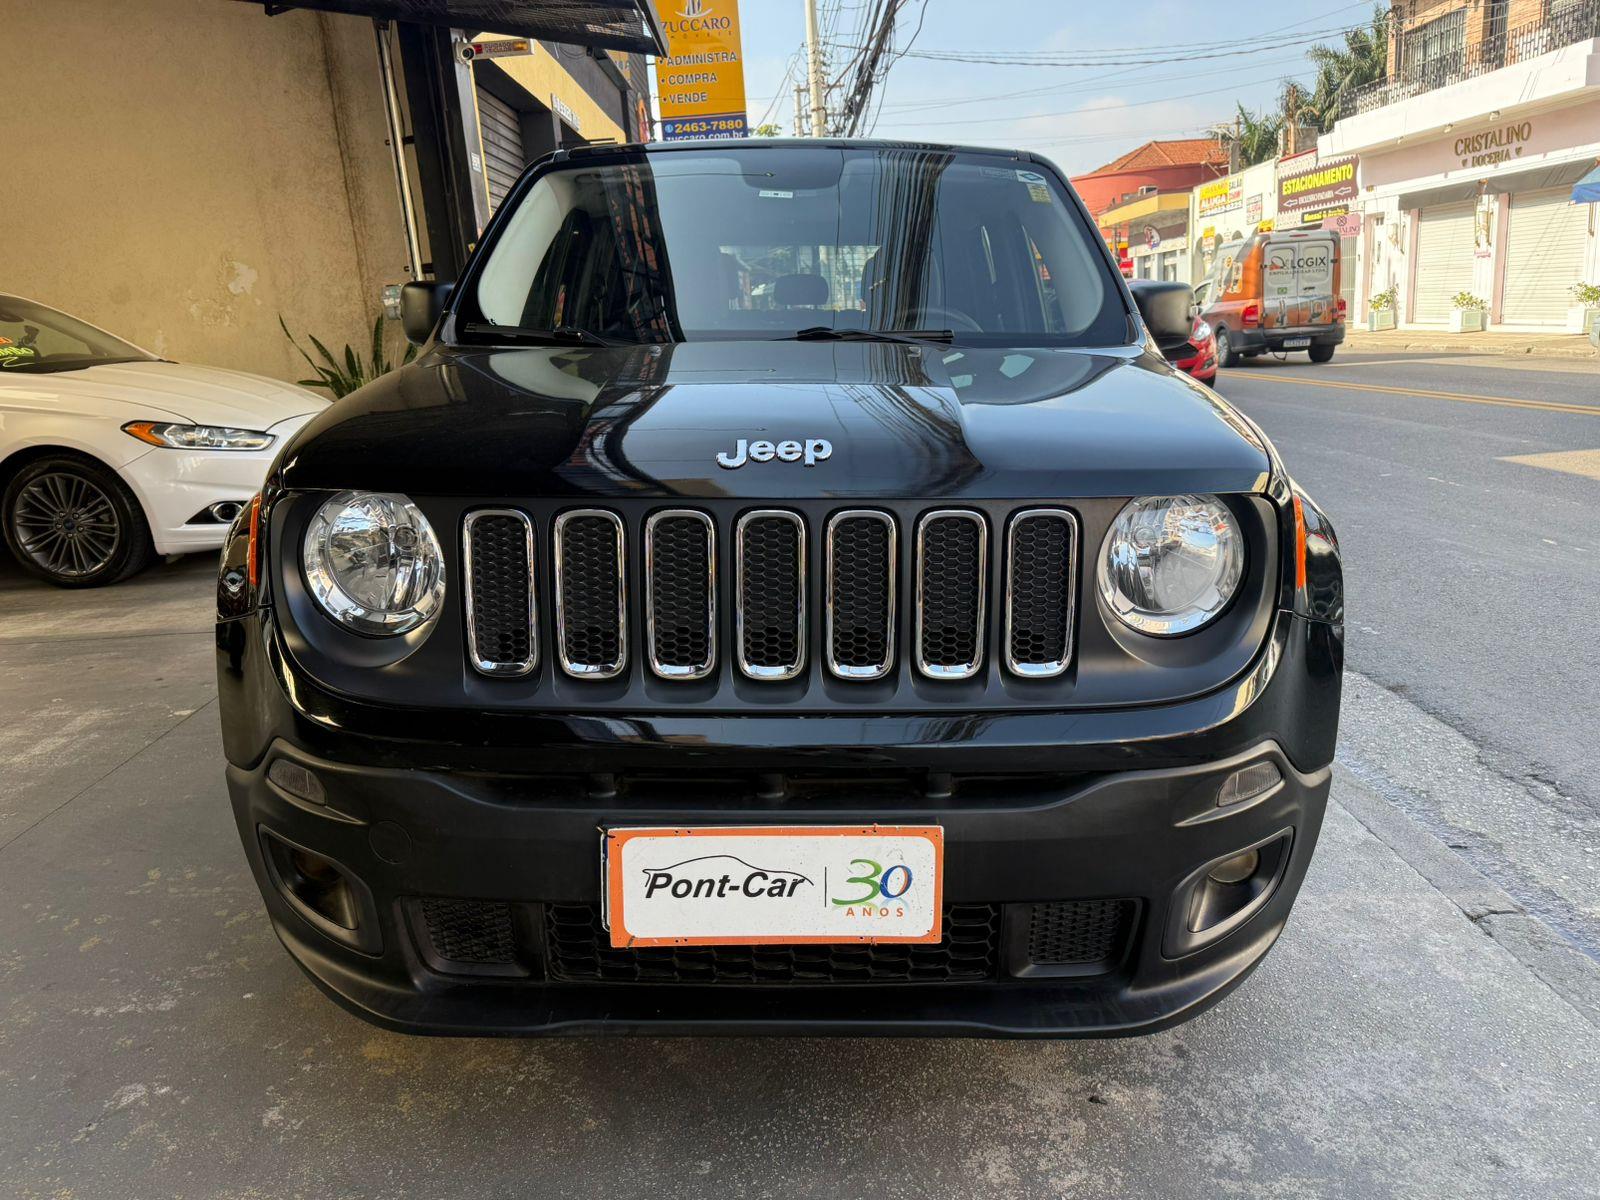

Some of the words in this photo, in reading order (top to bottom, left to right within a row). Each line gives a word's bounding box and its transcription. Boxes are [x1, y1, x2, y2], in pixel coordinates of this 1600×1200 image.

[660, 16, 731, 33] ZUCCARO
[667, 51, 738, 66] ADMINISTRA
[668, 72, 718, 85] COMPRA
[669, 91, 708, 104] VENDE
[674, 119, 744, 134] 2463-7880
[665, 130, 744, 141] zuccaro.com.br
[1454, 121, 1532, 156] CRISTALINO
[1471, 148, 1512, 168] DOCERIA
[1282, 163, 1354, 196] ESTACIONAMENTO
[716, 438, 833, 469] Jeep
[645, 871, 806, 899] Pont-Car
[831, 858, 913, 906] 30
[845, 907, 905, 918] ANOS
